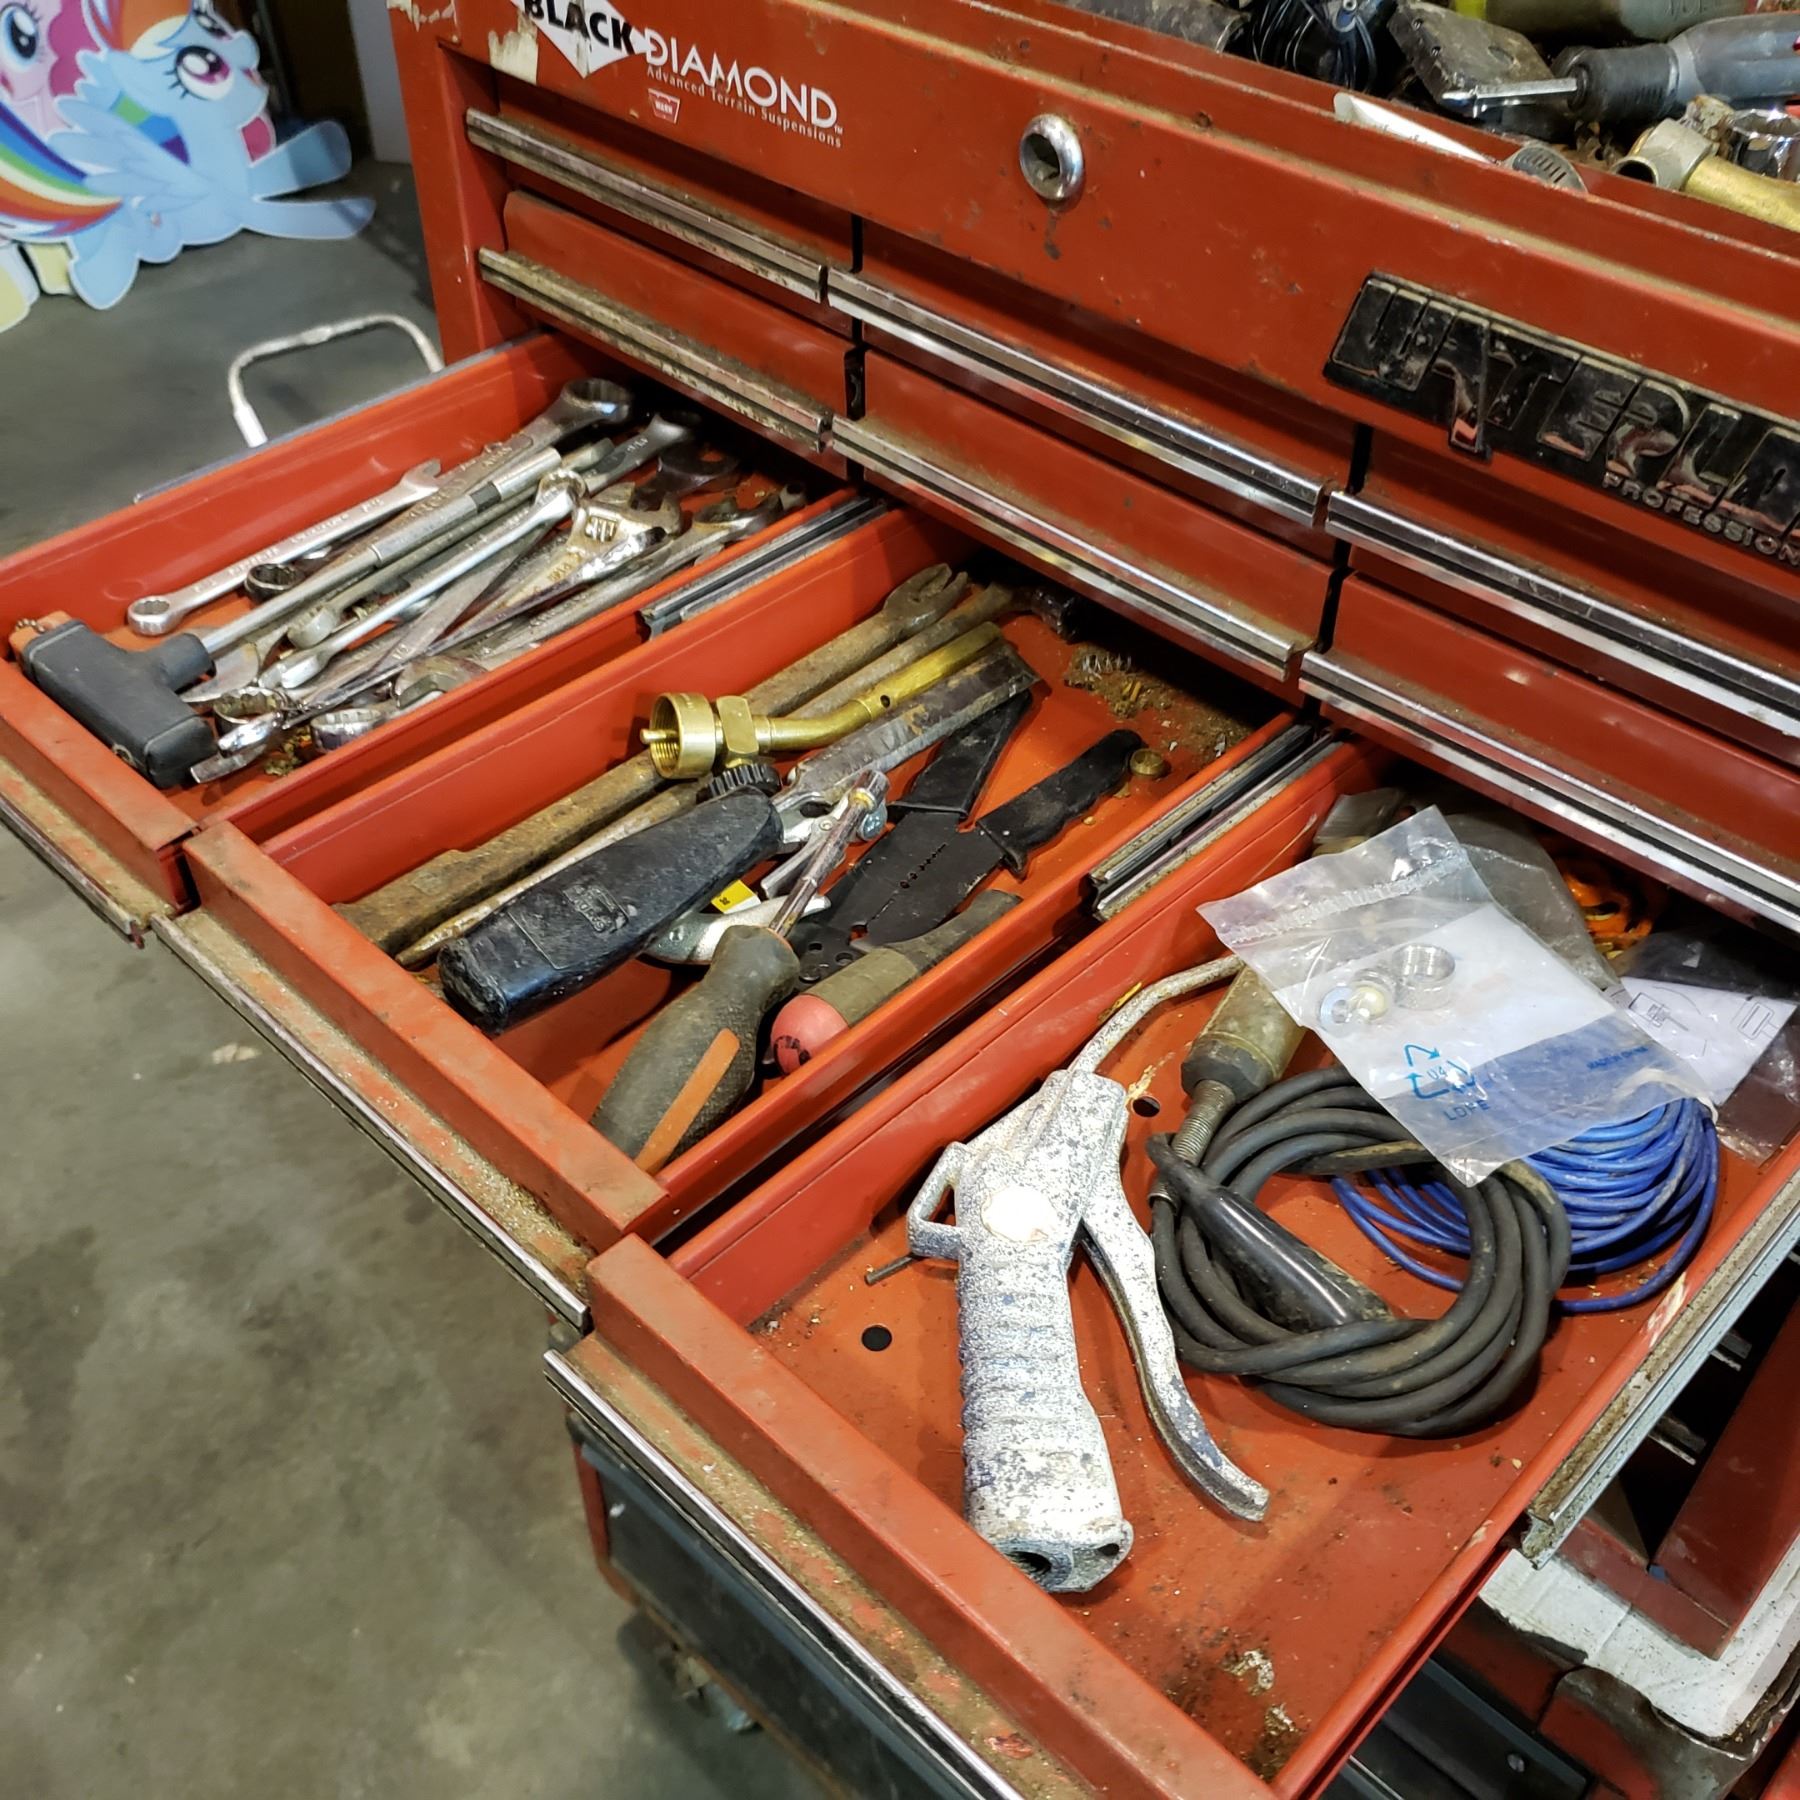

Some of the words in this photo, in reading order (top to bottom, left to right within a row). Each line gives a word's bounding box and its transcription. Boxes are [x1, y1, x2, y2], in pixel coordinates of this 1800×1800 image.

[524, 0, 636, 56] BLACK
[644, 28, 837, 129] DIAMOND
[646, 66, 705, 97] Advanced
[709, 87, 756, 117] Terrain
[761, 106, 842, 149] Suspensions
